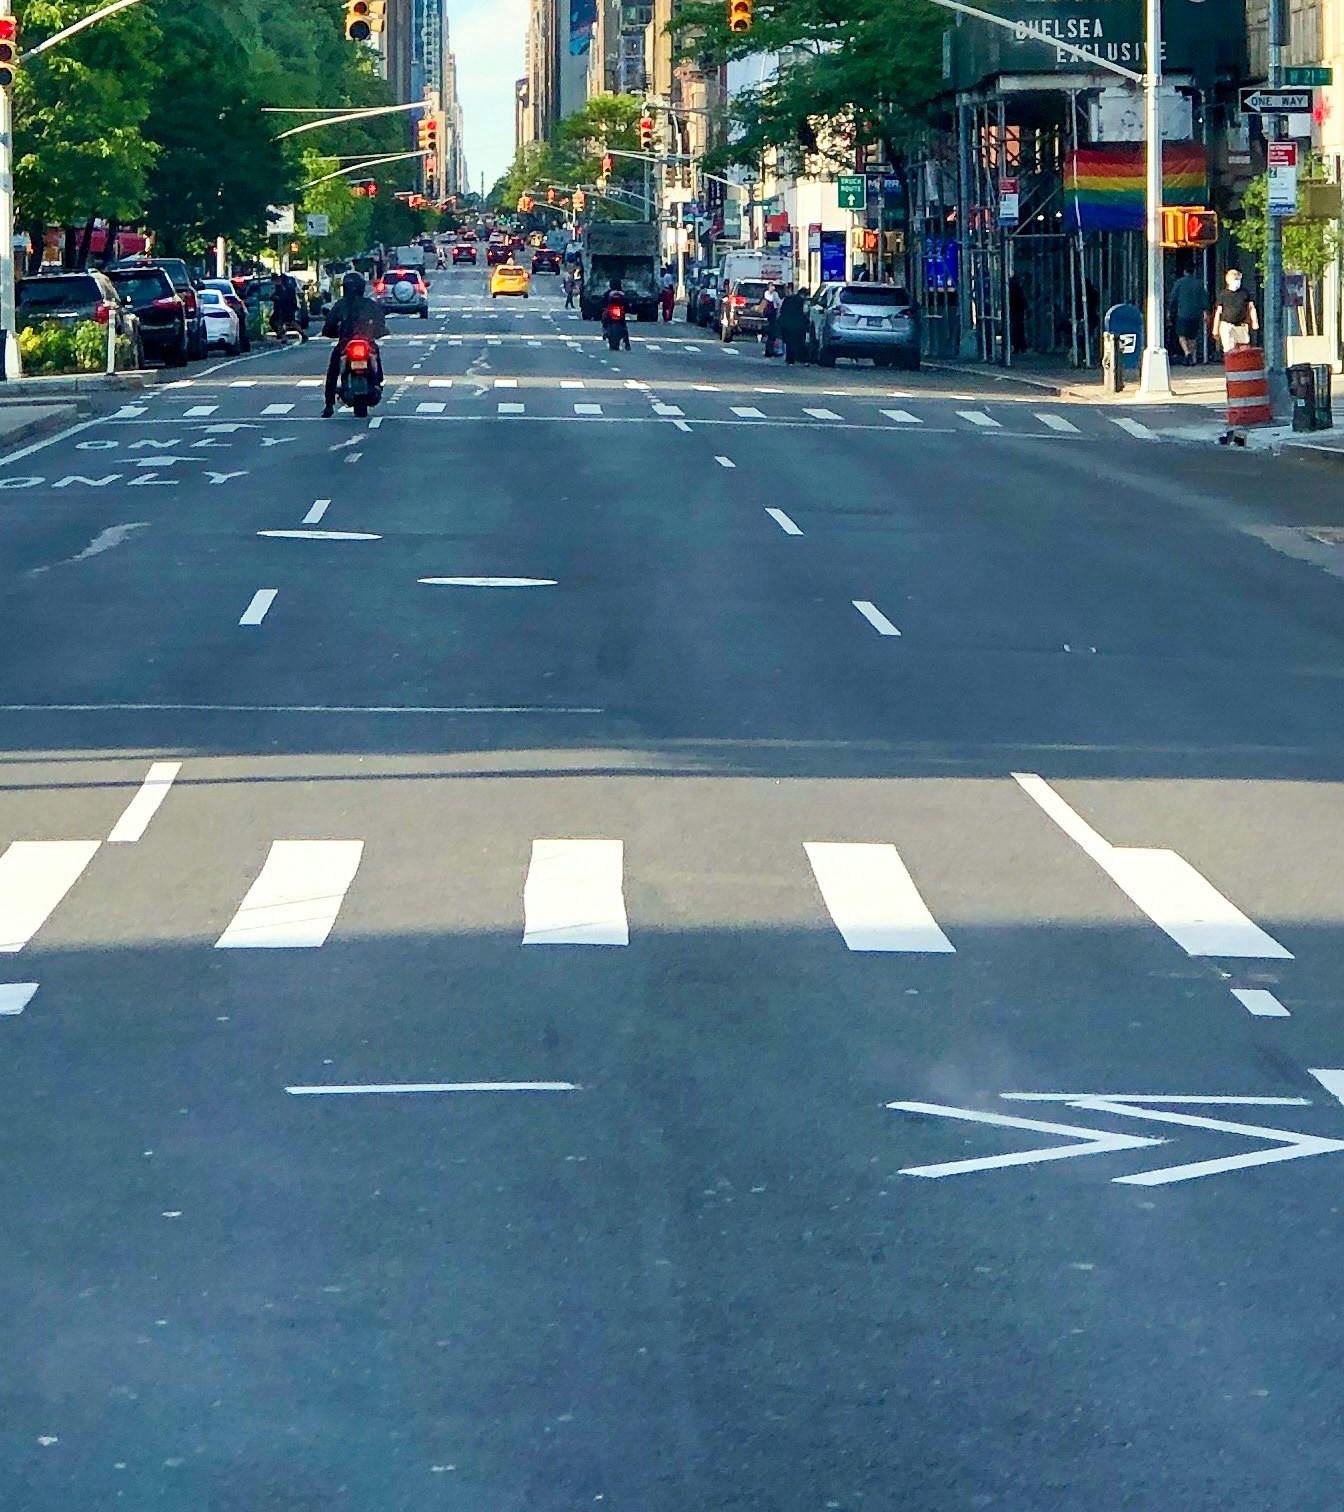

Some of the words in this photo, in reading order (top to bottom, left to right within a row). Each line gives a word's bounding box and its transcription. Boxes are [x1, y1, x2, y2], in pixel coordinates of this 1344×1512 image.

[1014, 18, 1104, 40] CHELSEA
[1056, 41, 1167, 63] EXCLUSIE
[1250, 96, 1273, 107] ONE
[1281, 95, 1304, 106] WAY
[74, 437, 299, 451] ONLY
